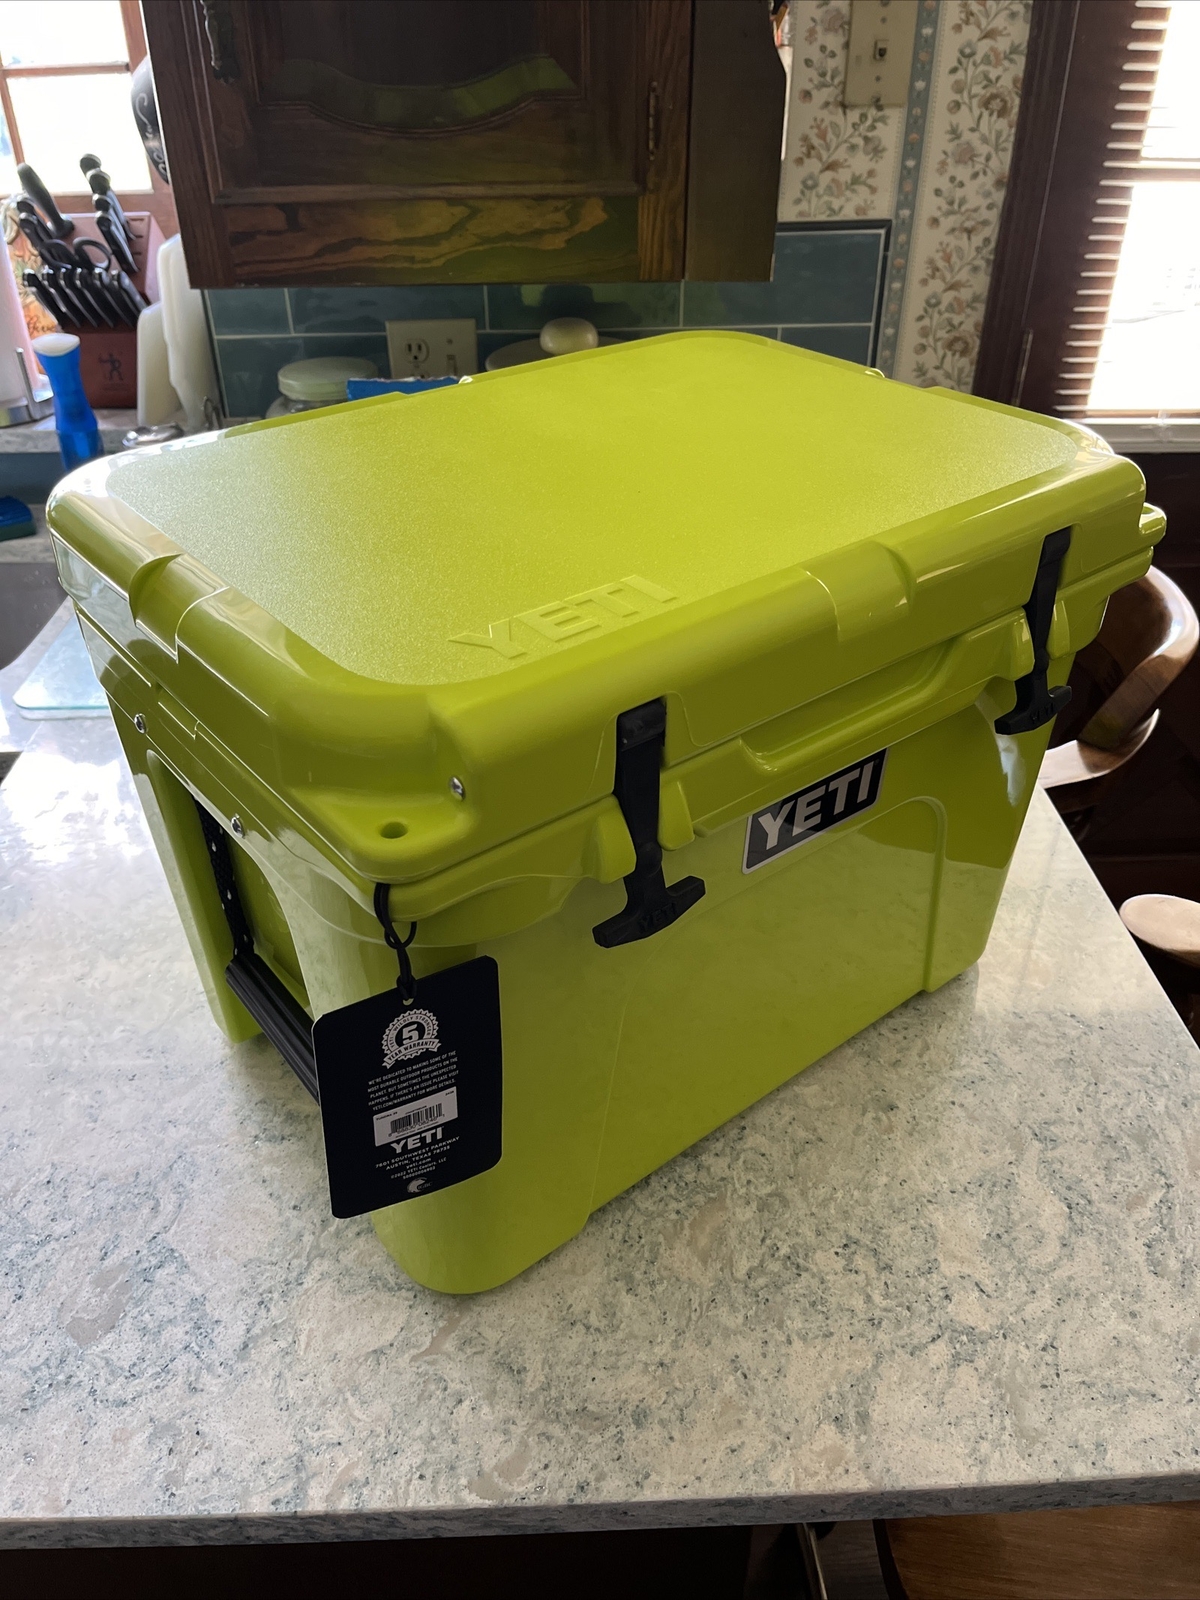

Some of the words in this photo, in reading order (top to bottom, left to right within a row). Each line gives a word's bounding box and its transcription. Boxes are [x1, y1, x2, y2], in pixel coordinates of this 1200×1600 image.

[448, 574, 678, 660] YETI
[758, 760, 875, 850] YETI
[402, 1023, 419, 1045] 5
[388, 1049, 403, 1061] YEAR
[403, 1041, 435, 1051] WARRANTY
[380, 1078, 399, 1088] DURABLE
[400, 1071, 420, 1081] OUTDOOR
[421, 1063, 442, 1073] PRODUCTS
[383, 1069, 406, 1080] DEDICATED
[413, 1061, 429, 1069] MAKING
[397, 1077, 421, 1089] SOMETIMES
[431, 1064, 456, 1077] UNEXPECTED
[395, 1087, 412, 1096] THERE'S
[433, 1074, 447, 1083] PLEASE
[373, 1093, 416, 1110] YETI.COM/WARRANTY
[391, 1127, 443, 1153] YETI
[391, 1147, 429, 1163] SOUTHWEST
[431, 1136, 459, 1149] PARKWAY
[386, 1160, 410, 1170] AUSTIN,
[412, 1152, 431, 1161] TEXAS
[433, 1145, 450, 1154] 78735
[406, 1158, 431, 1169] yeti.com
